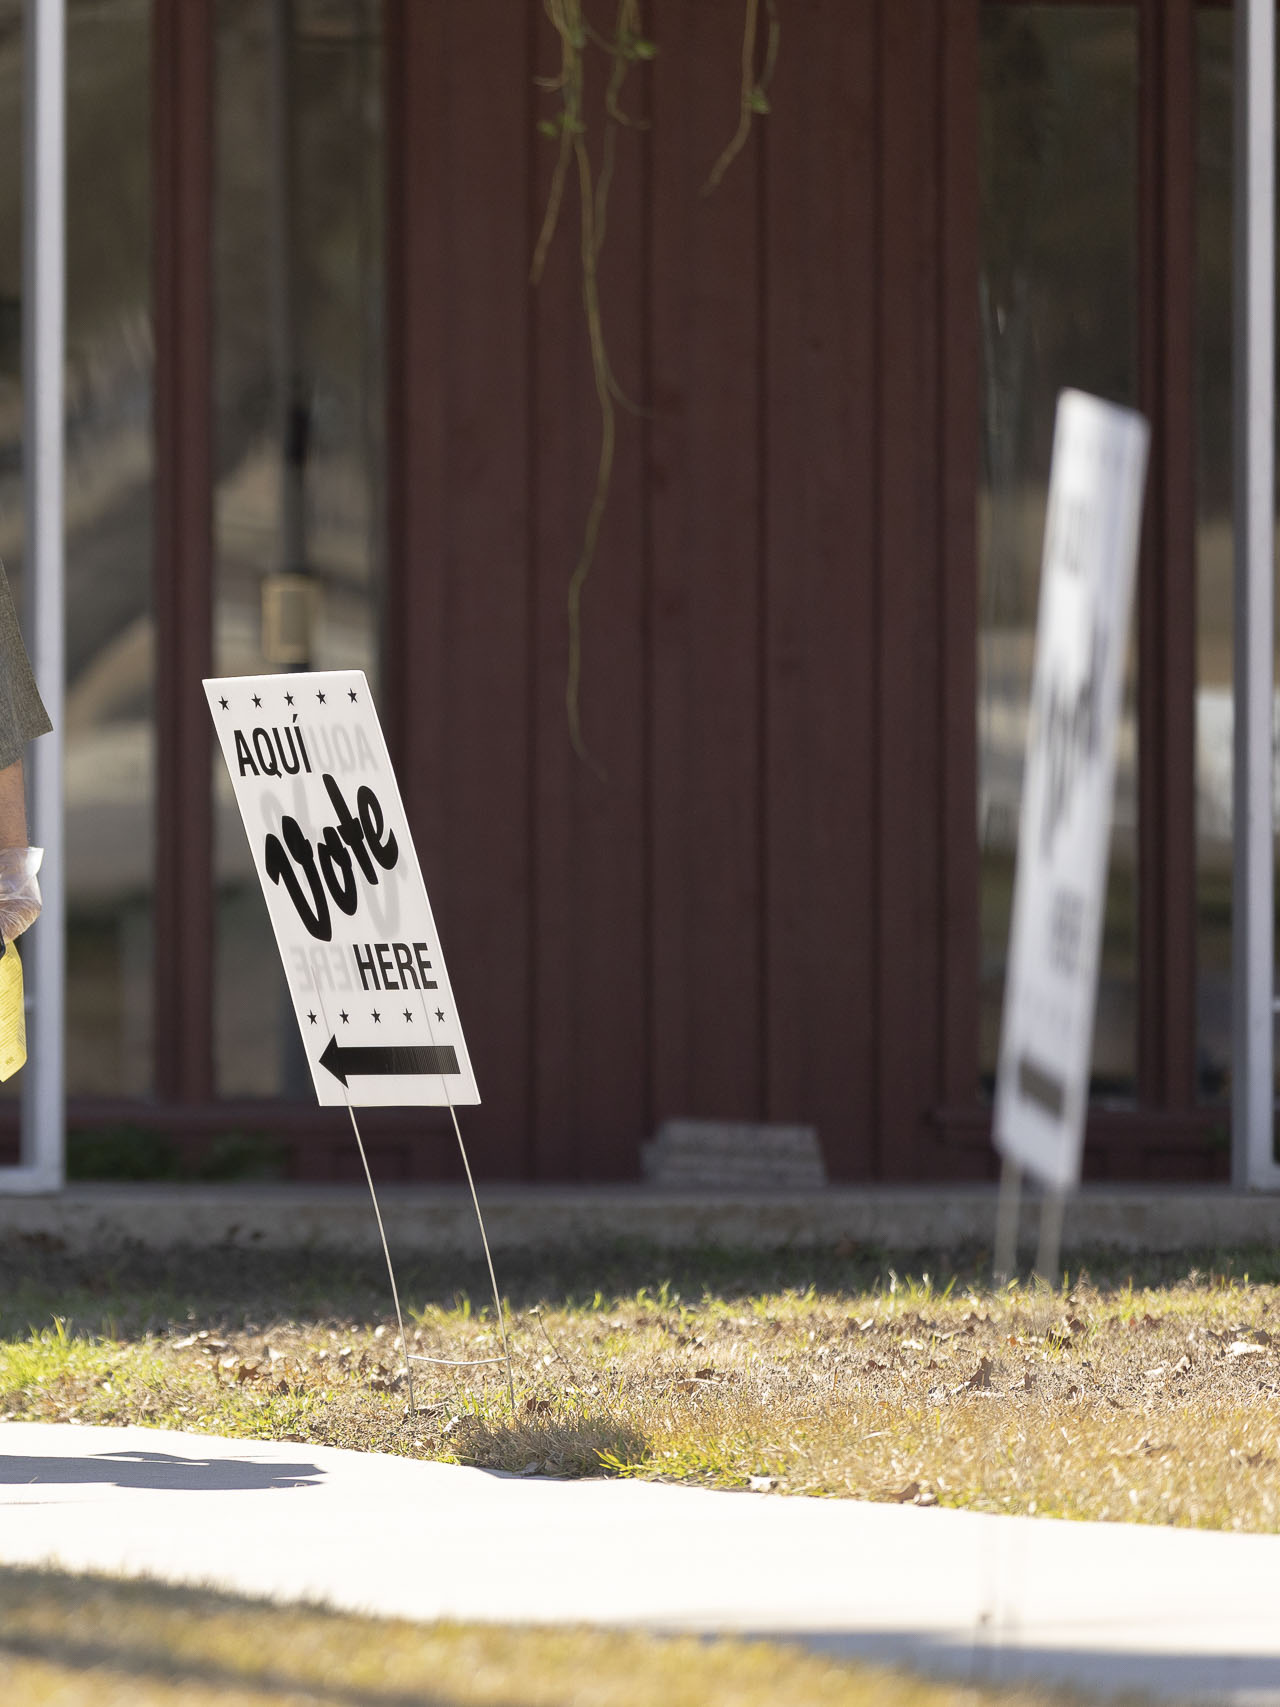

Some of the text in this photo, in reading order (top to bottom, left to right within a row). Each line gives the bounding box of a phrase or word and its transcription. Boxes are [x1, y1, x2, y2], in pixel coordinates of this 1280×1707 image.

[234, 713, 312, 779] AQUÍ
[264, 773, 399, 942] Vote
[352, 942, 439, 991] HERE
